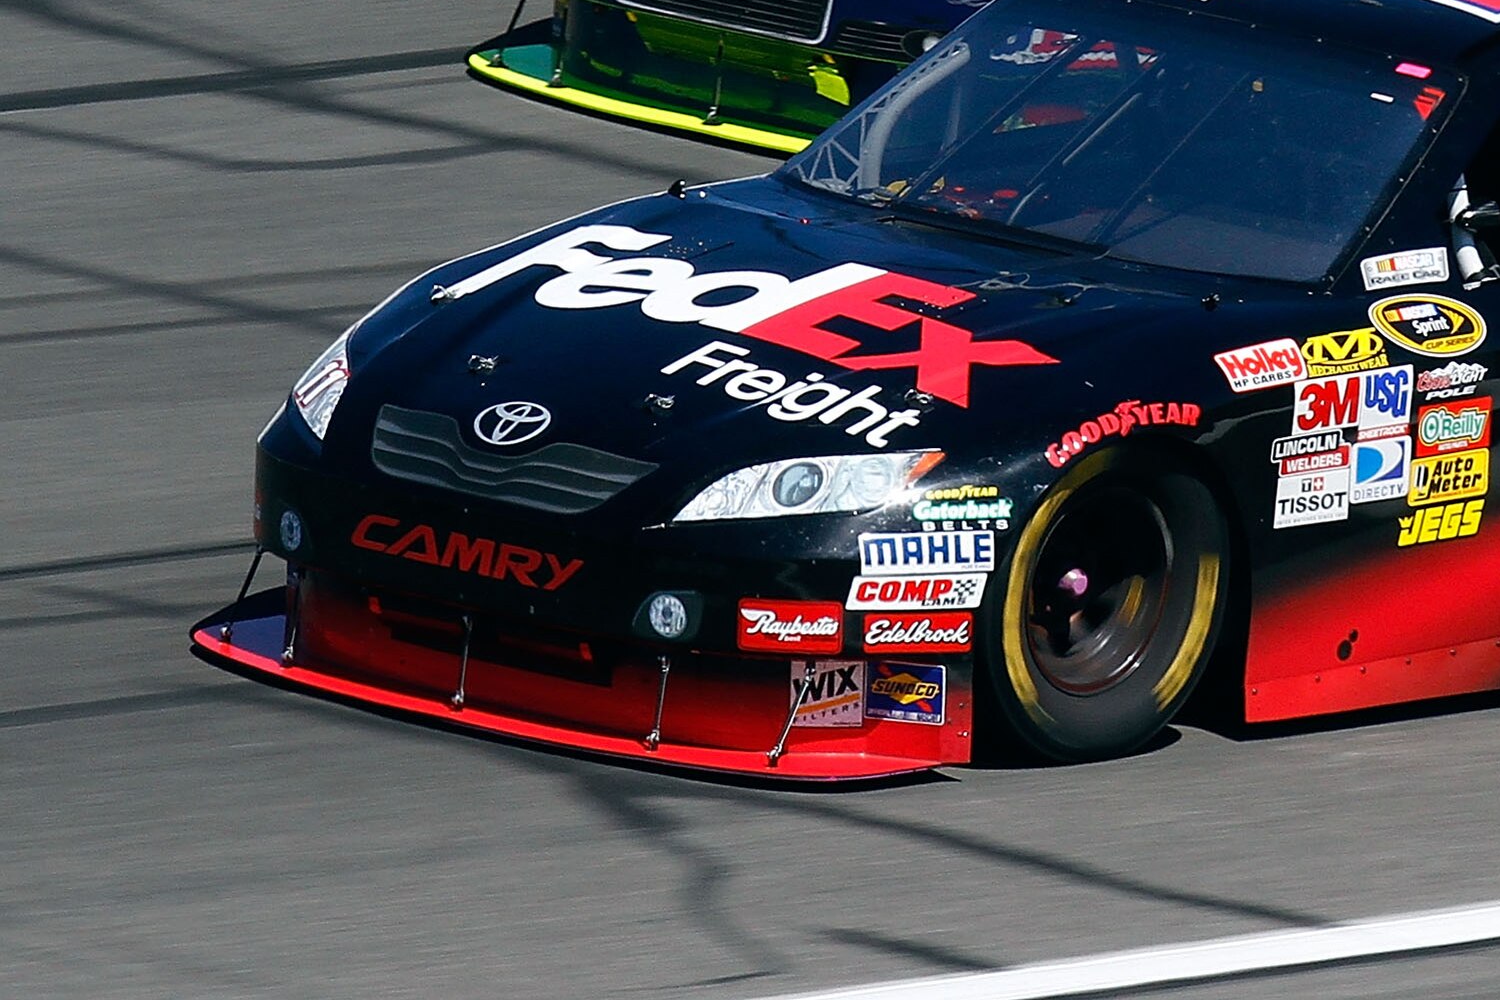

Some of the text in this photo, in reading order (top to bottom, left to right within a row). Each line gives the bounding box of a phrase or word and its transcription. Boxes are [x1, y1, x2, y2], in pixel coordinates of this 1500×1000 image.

[1412, 269, 1441, 280] CAR
[443, 224, 1060, 448] FedEx Freight
[1412, 316, 1450, 337] Sprint
[1425, 337, 1476, 350] CUP SERIES
[1219, 346, 1302, 378] Holley
[1308, 354, 1390, 378] MECHANIX WEAR
[294, 359, 351, 408] 11
[1233, 370, 1292, 388] HP CARBS
[1297, 376, 1360, 431] 3M
[1365, 370, 1408, 418] USG
[1425, 385, 1477, 401] POLE
[1045, 400, 1202, 468] GOODYEAR
[1423, 410, 1487, 442] O'Reilly
[1275, 433, 1337, 458] LINCOLN
[1286, 453, 1342, 473] WELDERS
[1432, 456, 1474, 478] Auto
[925, 484, 998, 500] GOODYEAR
[1429, 473, 1482, 495] Meter
[913, 498, 1013, 521] Gatorback
[1278, 491, 1347, 516] TISSOT
[922, 519, 1009, 532] BELTS
[1398, 499, 1486, 546] JEGS
[351, 514, 584, 591] CAMRY
[864, 534, 991, 566] MAHLE
[856, 579, 953, 603] COMP
[865, 620, 969, 644] Edelbrock
[793, 664, 860, 706] WIX
[872, 679, 938, 697] SUNOCO
[794, 702, 860, 724] FILTERS
